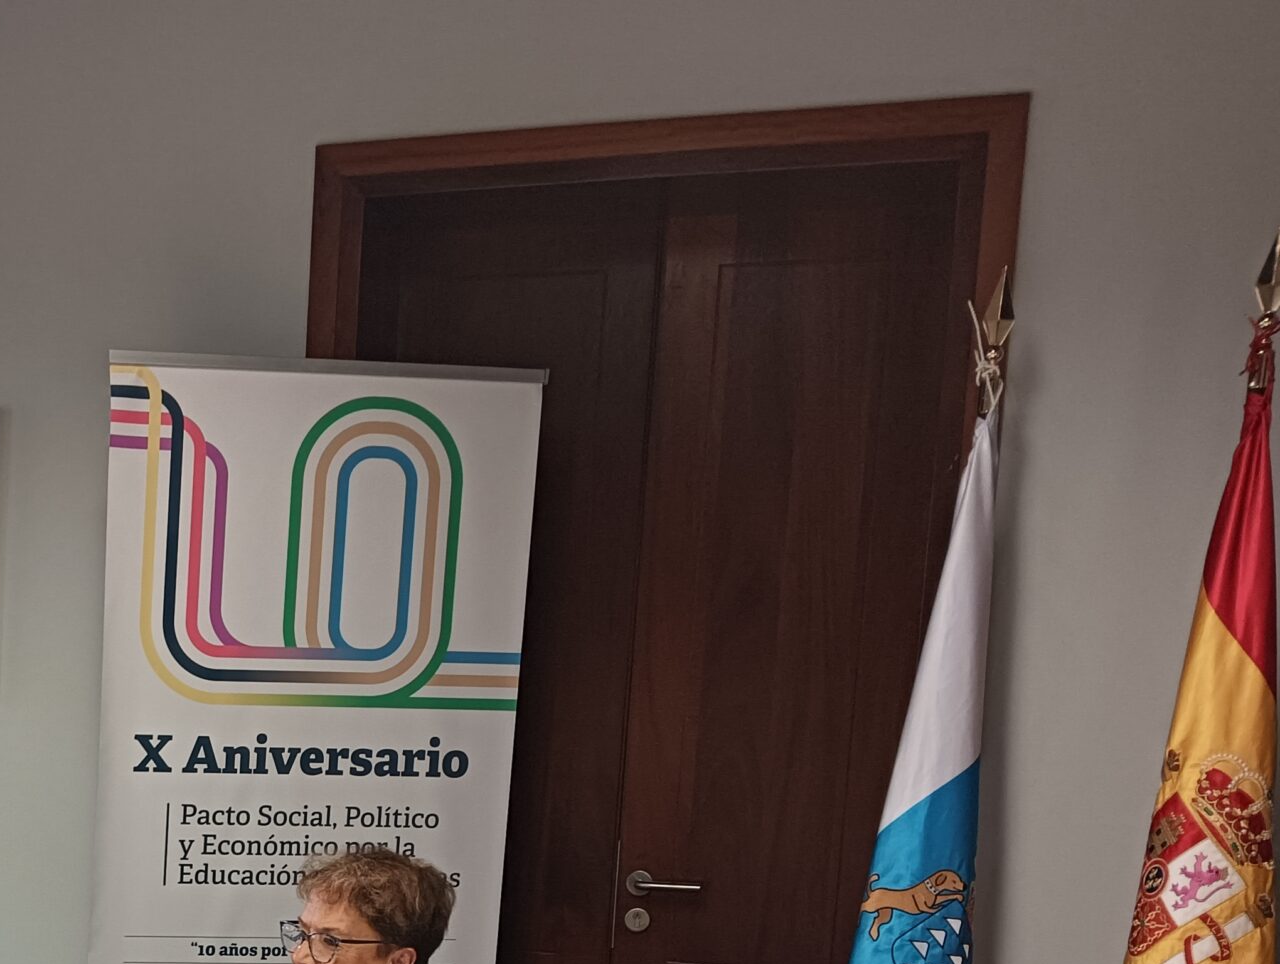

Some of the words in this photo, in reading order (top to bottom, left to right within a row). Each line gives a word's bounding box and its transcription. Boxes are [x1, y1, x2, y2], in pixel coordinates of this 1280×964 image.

[133, 734, 173, 773] X
[182, 732, 470, 779] Aniversario
[180, 803, 251, 826] Pacto
[258, 804, 338, 830] Social,
[344, 805, 440, 829] Político
[178, 838, 195, 860] y
[201, 833, 338, 858] Económico
[395, 836, 415, 858] la
[178, 863, 307, 887] Educación
[219, 942, 258, 957] años
